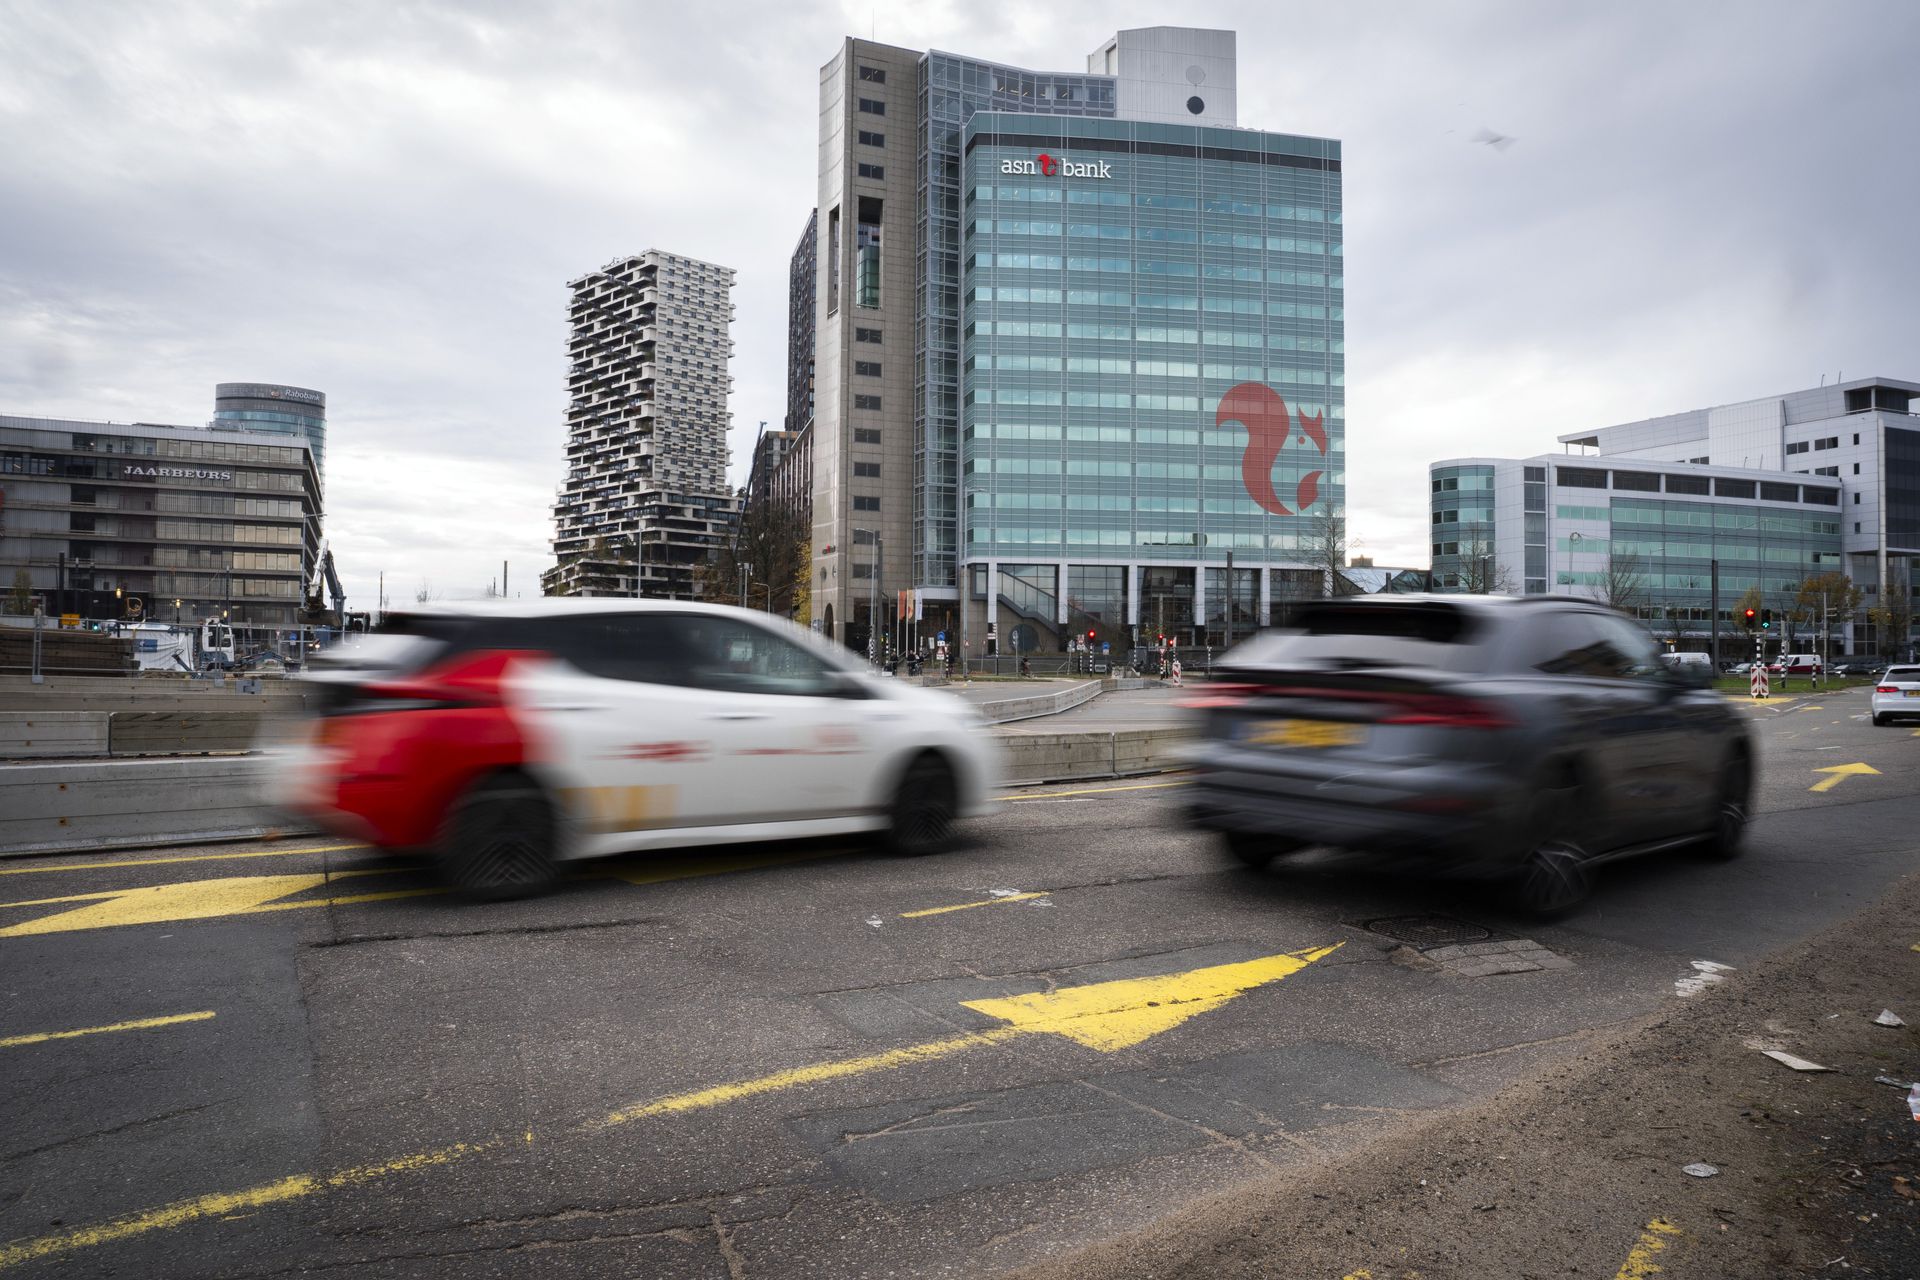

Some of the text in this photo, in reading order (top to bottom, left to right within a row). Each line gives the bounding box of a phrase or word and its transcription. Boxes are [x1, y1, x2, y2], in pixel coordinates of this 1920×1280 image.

[1001, 158, 1111, 179] asn bank
[285, 389, 320, 401] Rabobank
[124, 465, 231, 480] JAARBEURS
